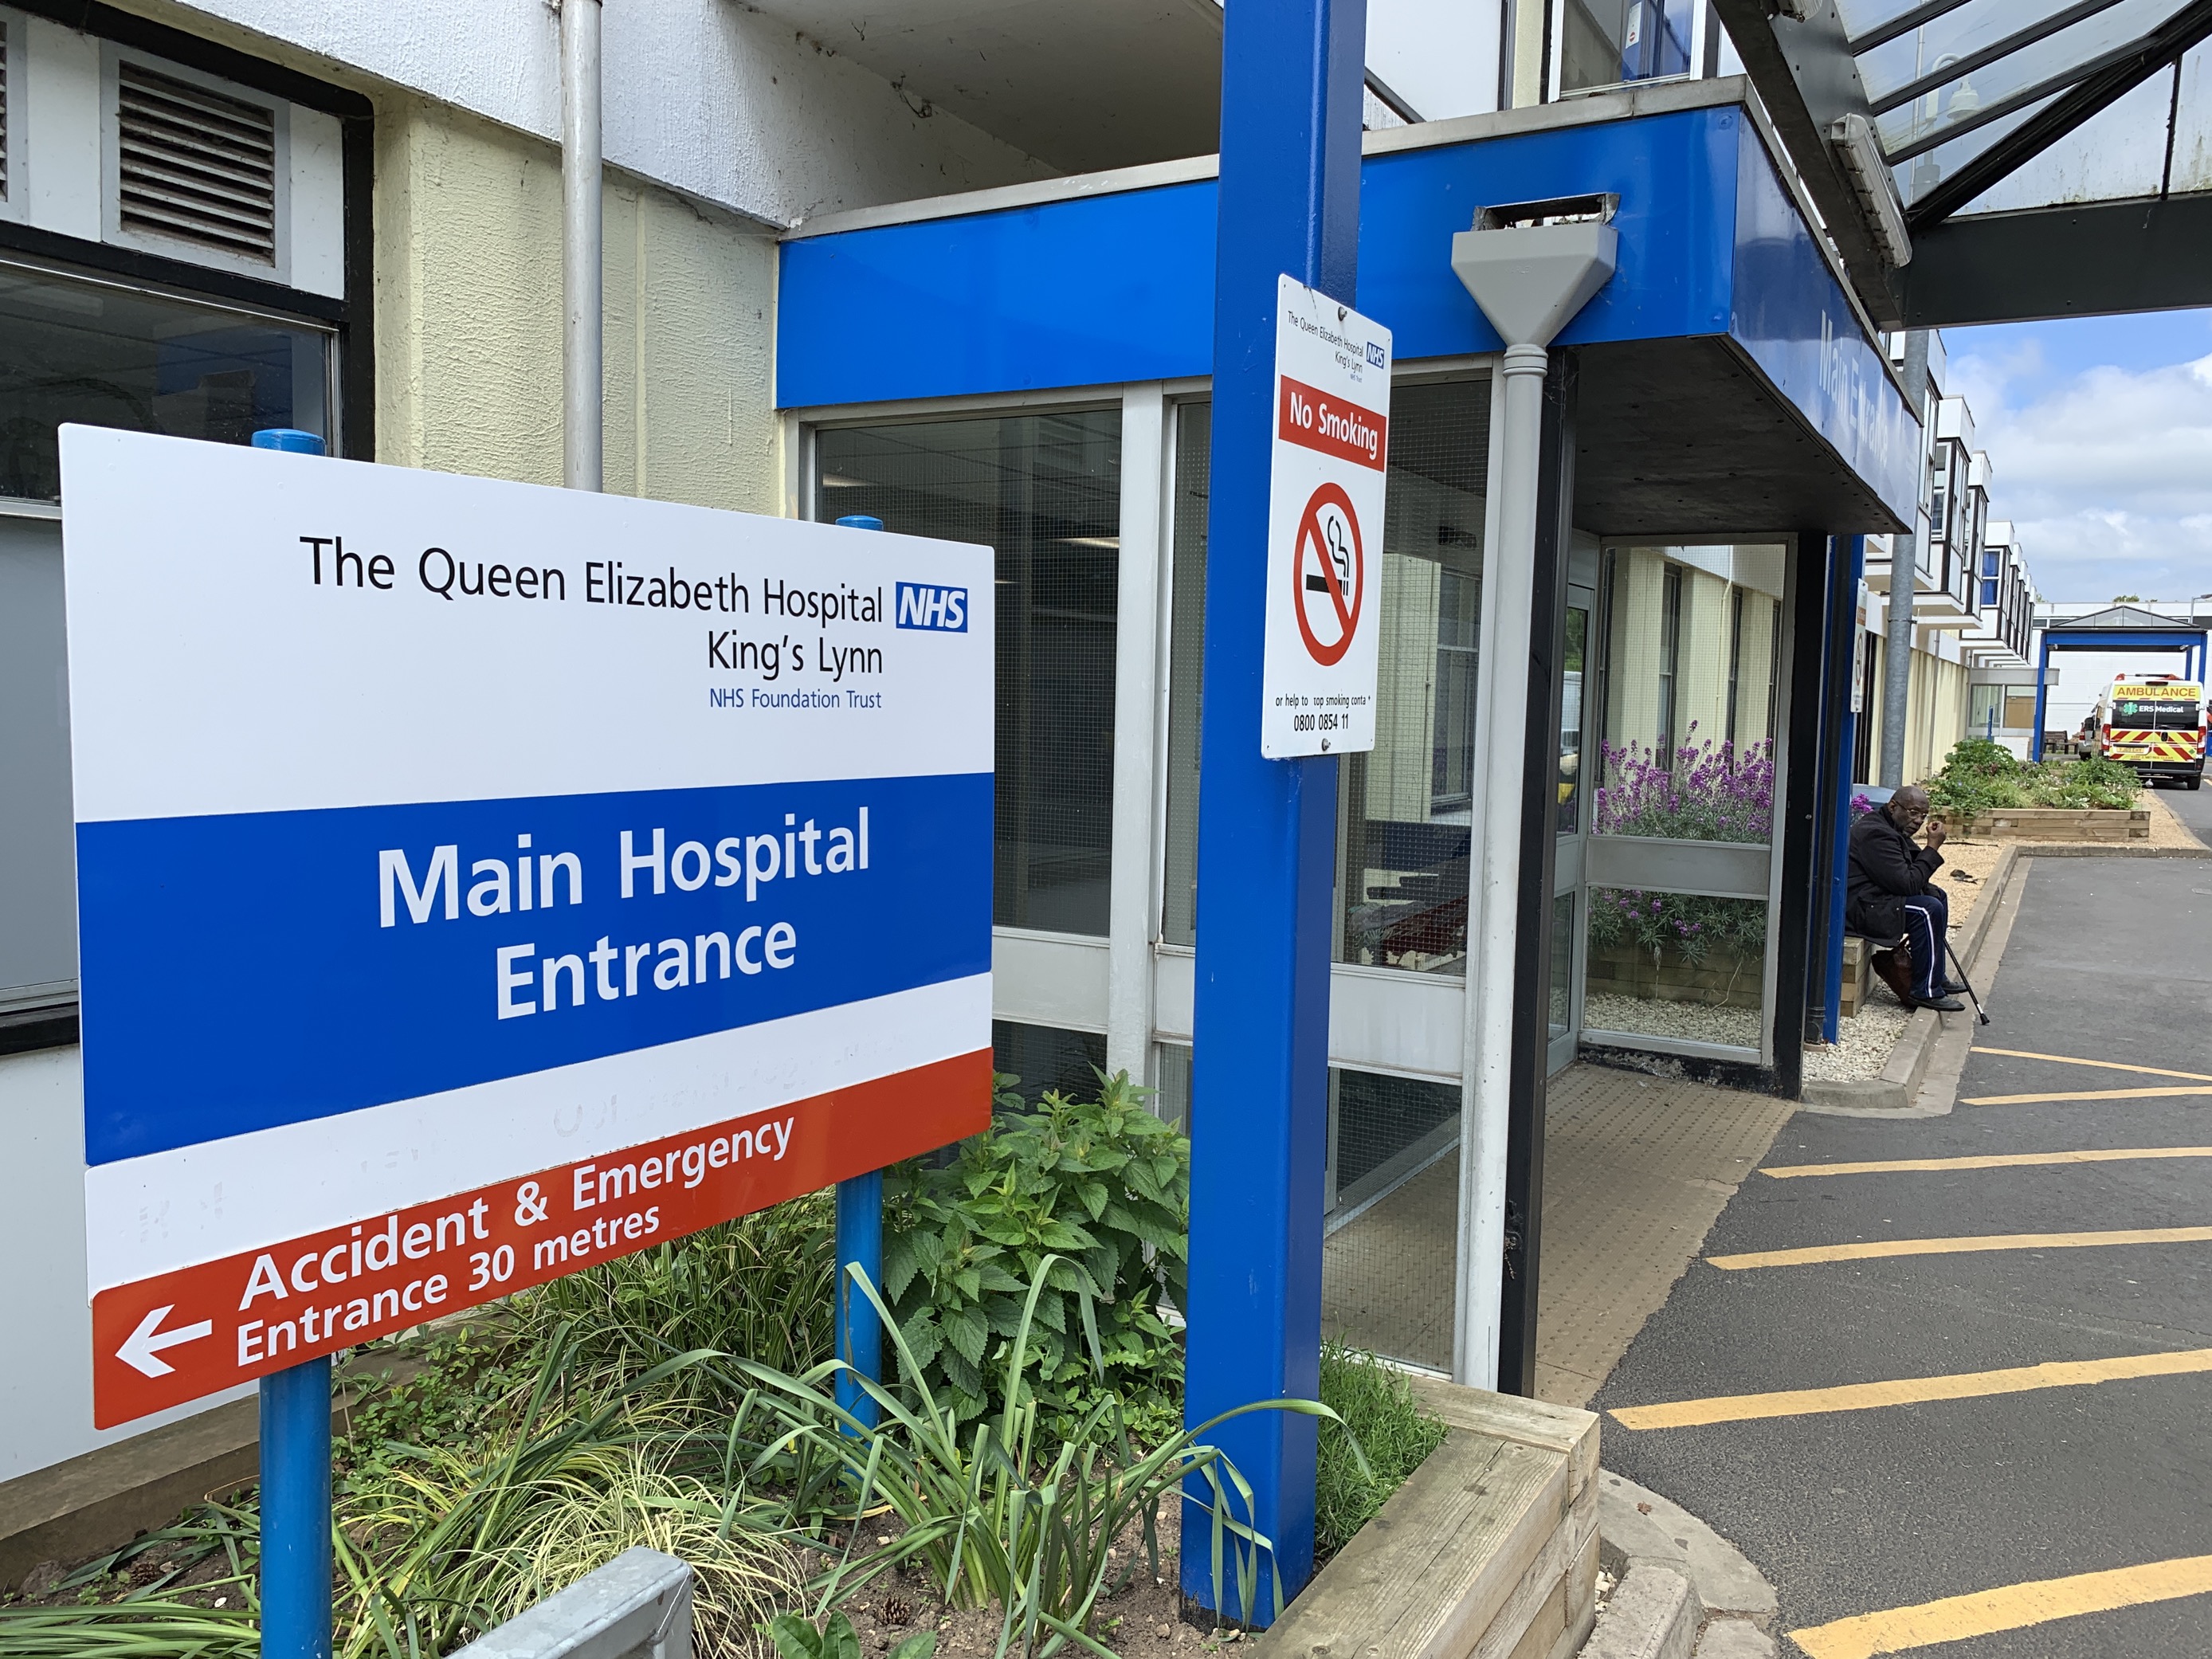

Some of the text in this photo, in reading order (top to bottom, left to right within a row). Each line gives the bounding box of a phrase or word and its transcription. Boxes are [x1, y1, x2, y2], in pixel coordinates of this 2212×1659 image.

[1288, 310, 1364, 358] The Queen Elizabeth Hospital
[1367, 342, 1384, 370] NHS
[1335, 351, 1363, 374] King's Lynn
[1818, 308, 1848, 418] Main
[1290, 391, 1379, 461] No Smoking
[299, 535, 882, 629] The Queen Elizabeth Hospital
[896, 582, 967, 632] NHS
[819, 637, 882, 684] Lynn
[710, 688, 882, 709] NHS Foundation Trust
[1284, 693, 1300, 710] help
[1301, 695, 1308, 707] to
[1313, 696, 1324, 709] top
[1325, 693, 1350, 709] smoking
[1351, 695, 1371, 706] conta
[2117, 687, 2196, 697] AMBULANCE
[1293, 712, 1349, 732] 0800 0854 11
[378, 806, 869, 928] Main Hospital
[496, 921, 796, 1021] Entrance
[237, 1116, 794, 1312] Accident & Emergency
[237, 1206, 660, 1367] Entrance 30 metres
